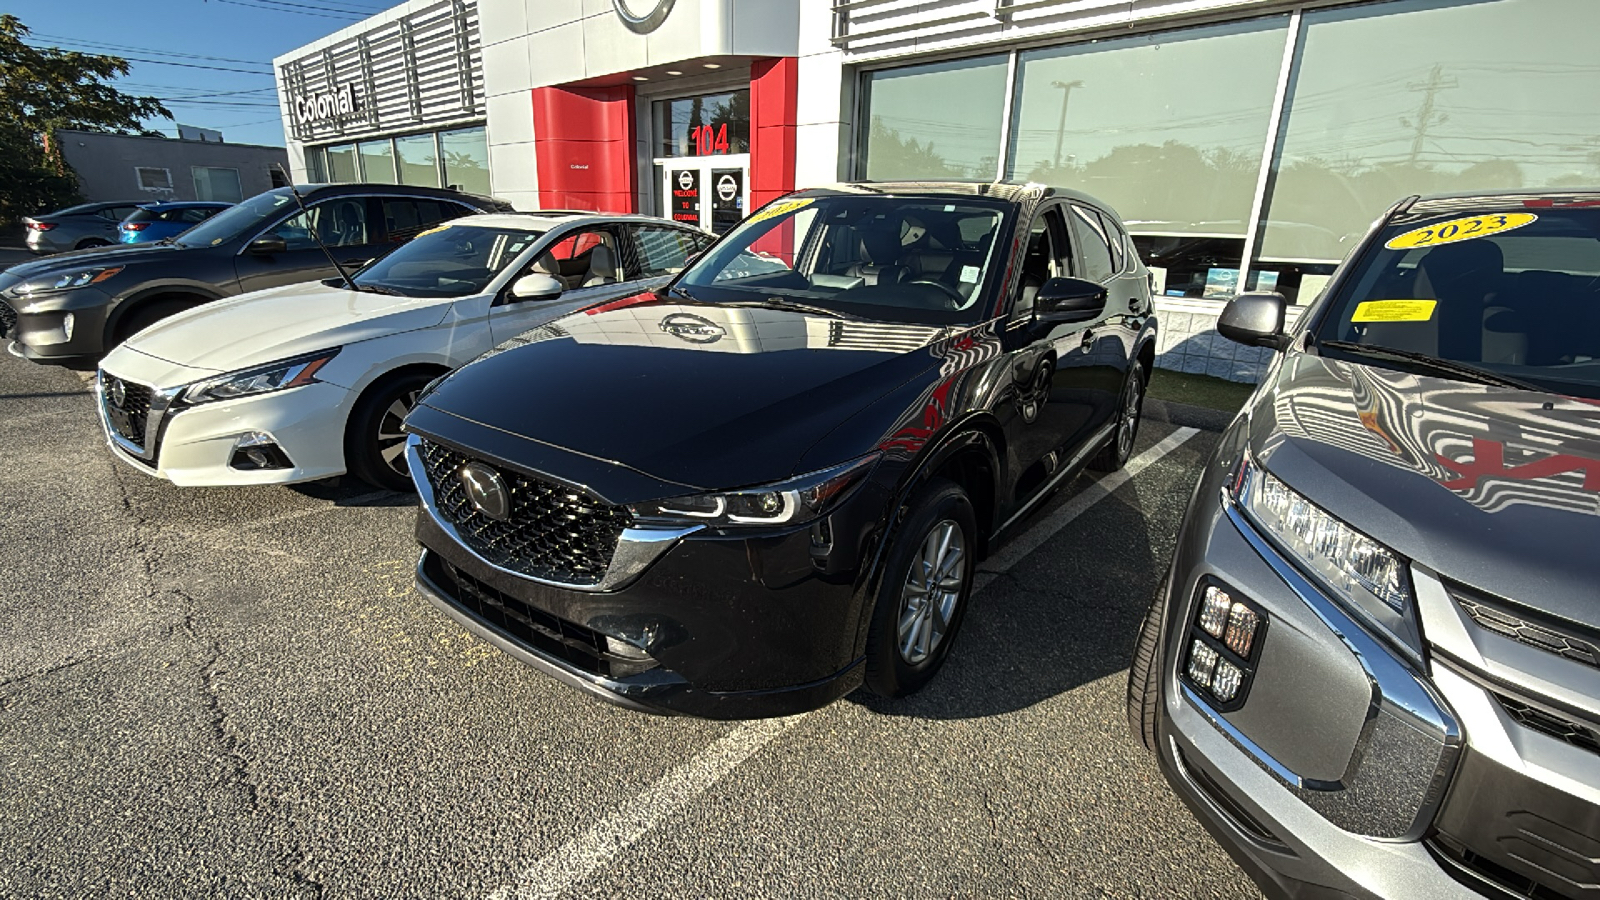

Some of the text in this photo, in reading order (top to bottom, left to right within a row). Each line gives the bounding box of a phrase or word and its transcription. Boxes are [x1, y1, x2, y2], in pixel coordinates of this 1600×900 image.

[295, 82, 355, 124] Colonial
[691, 123, 729, 157] 104
[1413, 216, 1508, 246] 2023
